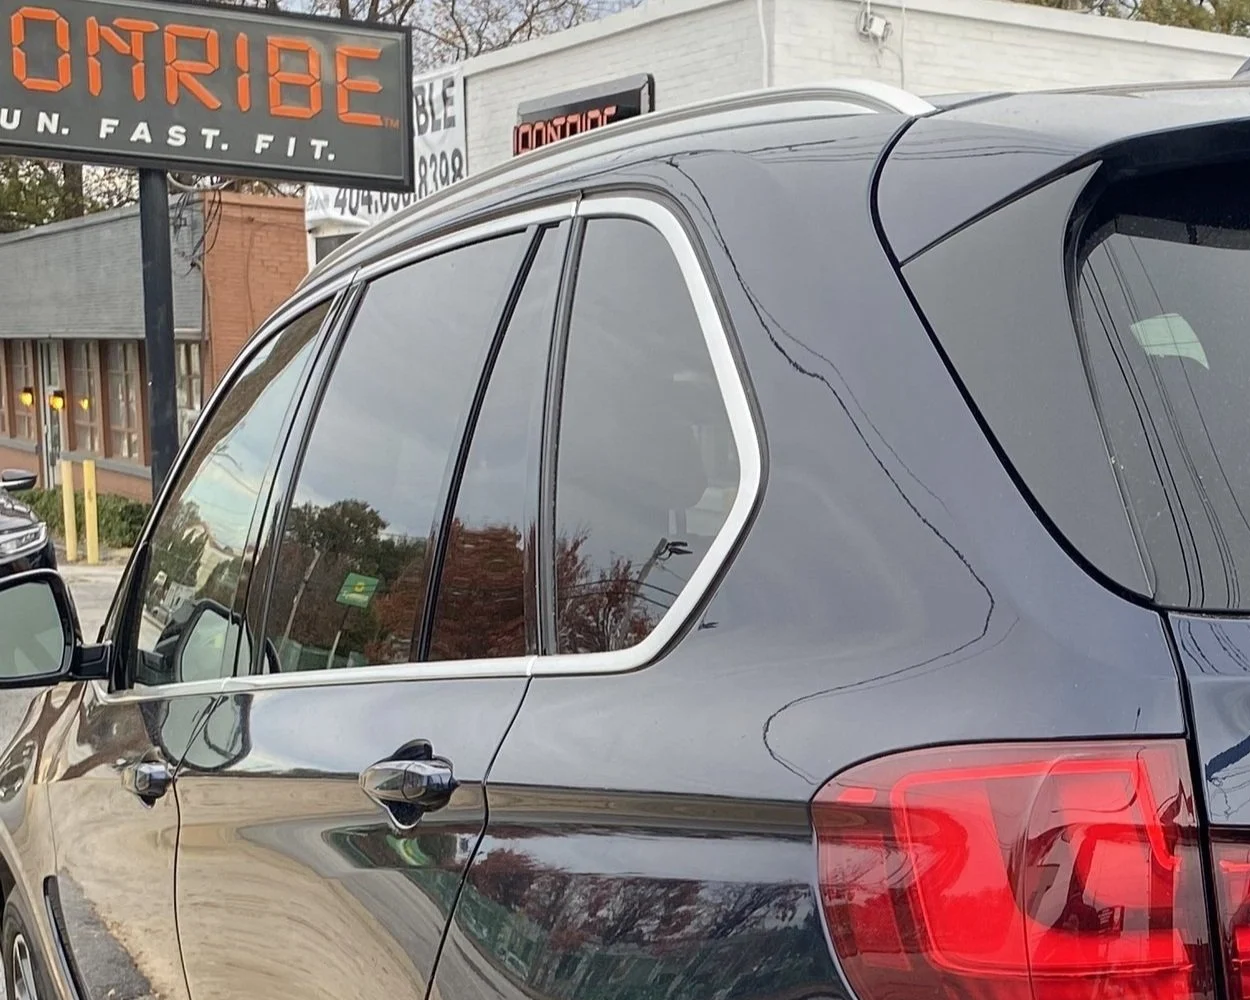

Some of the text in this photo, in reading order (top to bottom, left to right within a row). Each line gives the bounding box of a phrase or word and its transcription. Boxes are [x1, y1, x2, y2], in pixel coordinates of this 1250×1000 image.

[412, 76, 456, 136] BLE
[99, 118, 229, 151] FAST.
[254, 133, 335, 161] FIT.
